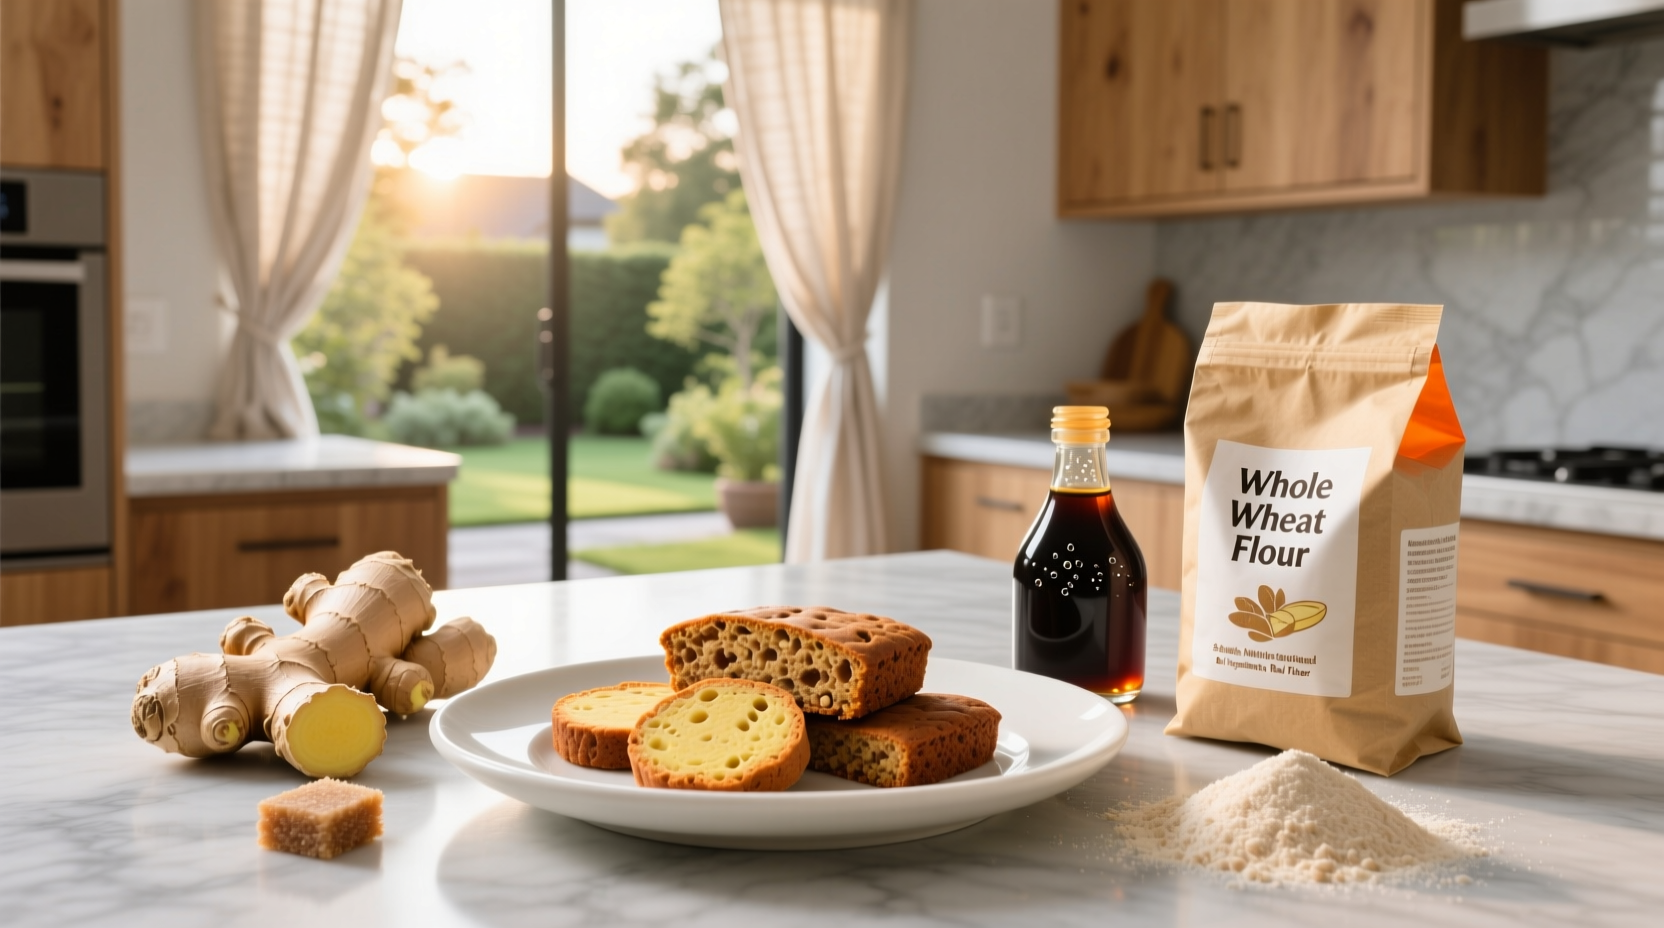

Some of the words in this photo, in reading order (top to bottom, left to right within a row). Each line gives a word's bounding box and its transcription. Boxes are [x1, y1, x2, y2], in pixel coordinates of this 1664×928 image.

[1241, 467, 1333, 499] Whole
[1232, 499, 1326, 534] Wheat
[1231, 534, 1310, 568] Flour
